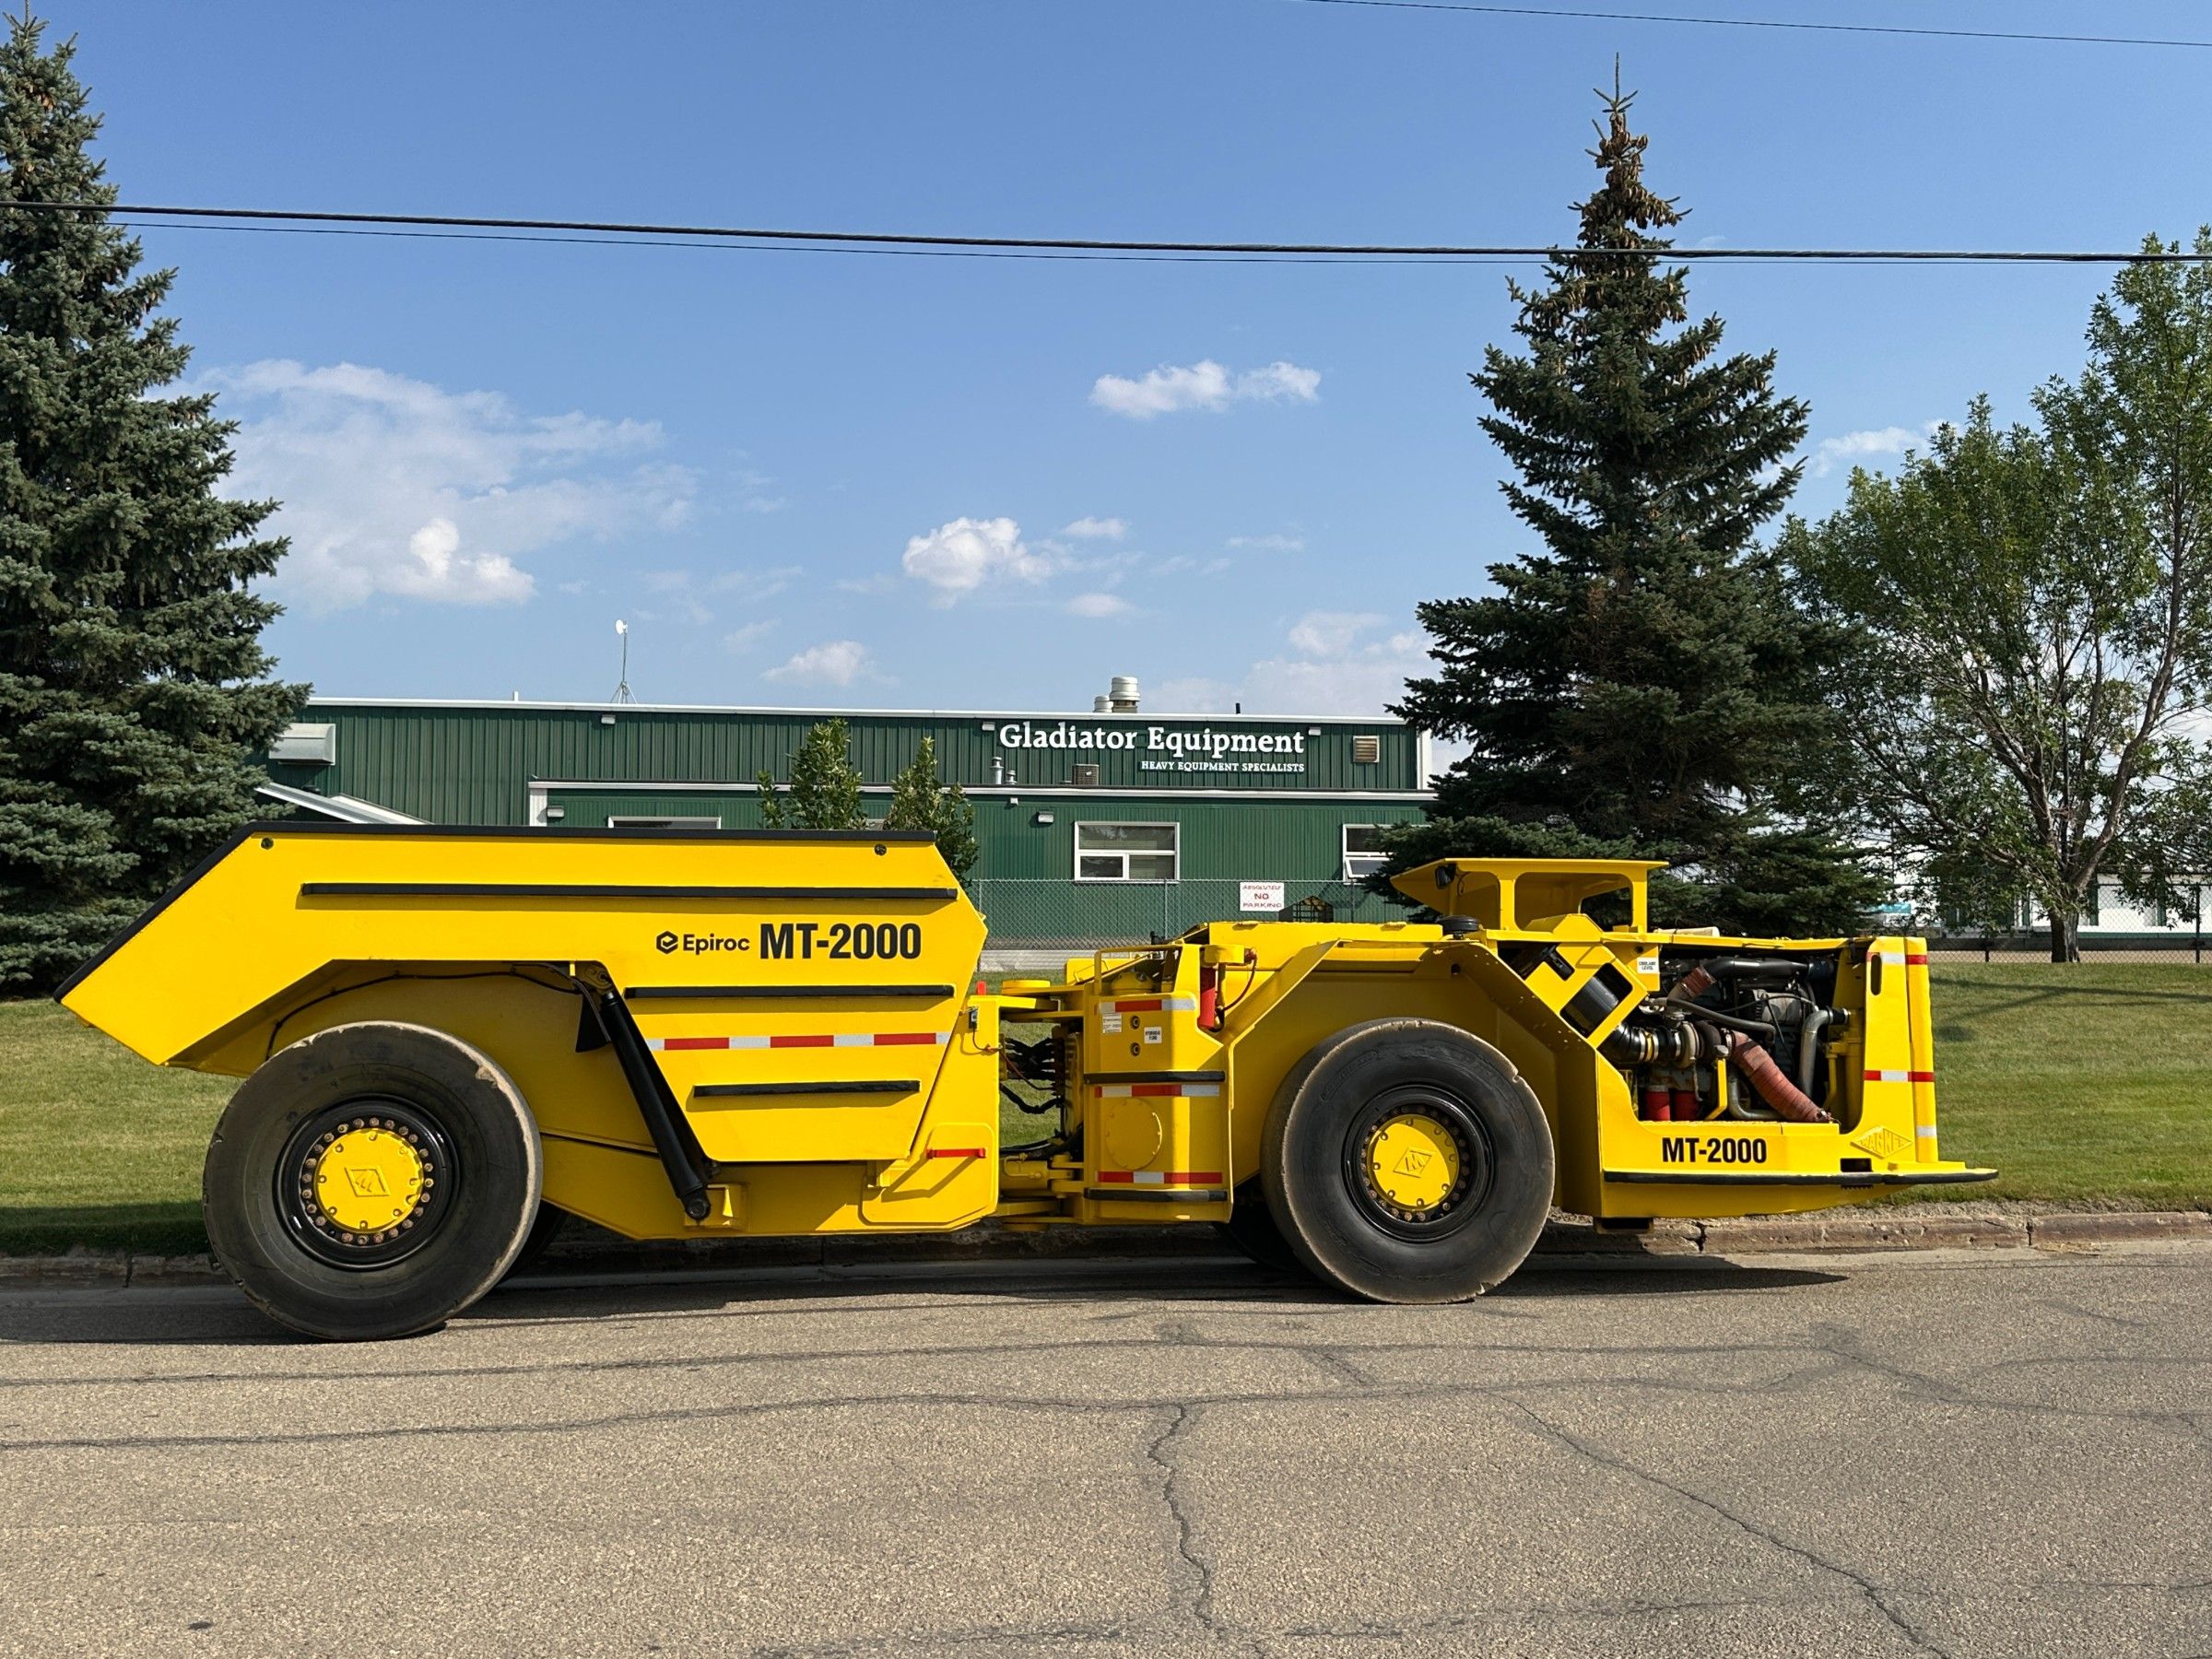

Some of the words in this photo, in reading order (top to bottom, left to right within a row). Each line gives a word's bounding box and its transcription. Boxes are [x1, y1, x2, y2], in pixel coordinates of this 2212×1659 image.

[999, 721, 1138, 749] Gladiator
[1147, 726, 1305, 759] Equipment
[1141, 760, 1174, 771] HEAVY
[1177, 761, 1240, 772] EQUIPMENT
[1241, 763, 1305, 772] SPECIALISTS
[683, 933, 750, 955] Epiroc
[759, 923, 922, 959] MT-2000
[1662, 1137, 1767, 1163] MT-2000
